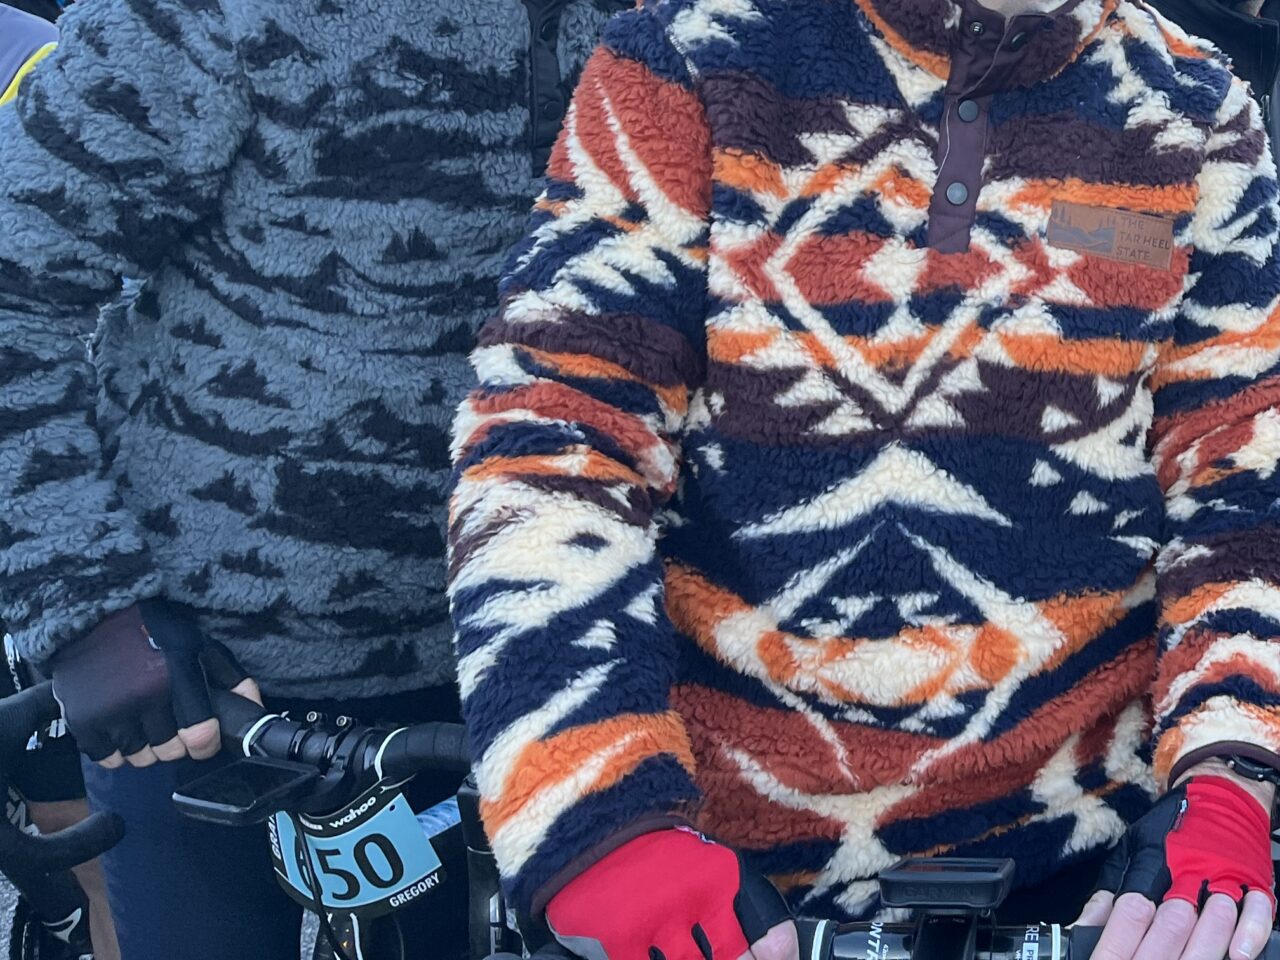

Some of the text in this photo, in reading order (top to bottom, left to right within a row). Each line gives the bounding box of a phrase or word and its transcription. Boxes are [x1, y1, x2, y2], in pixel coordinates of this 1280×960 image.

[1116, 246, 1152, 261] STATE
[1143, 235, 1172, 251] HEEL
[329, 796, 377, 828] wahoo
[388, 872, 440, 908] GREGORY
